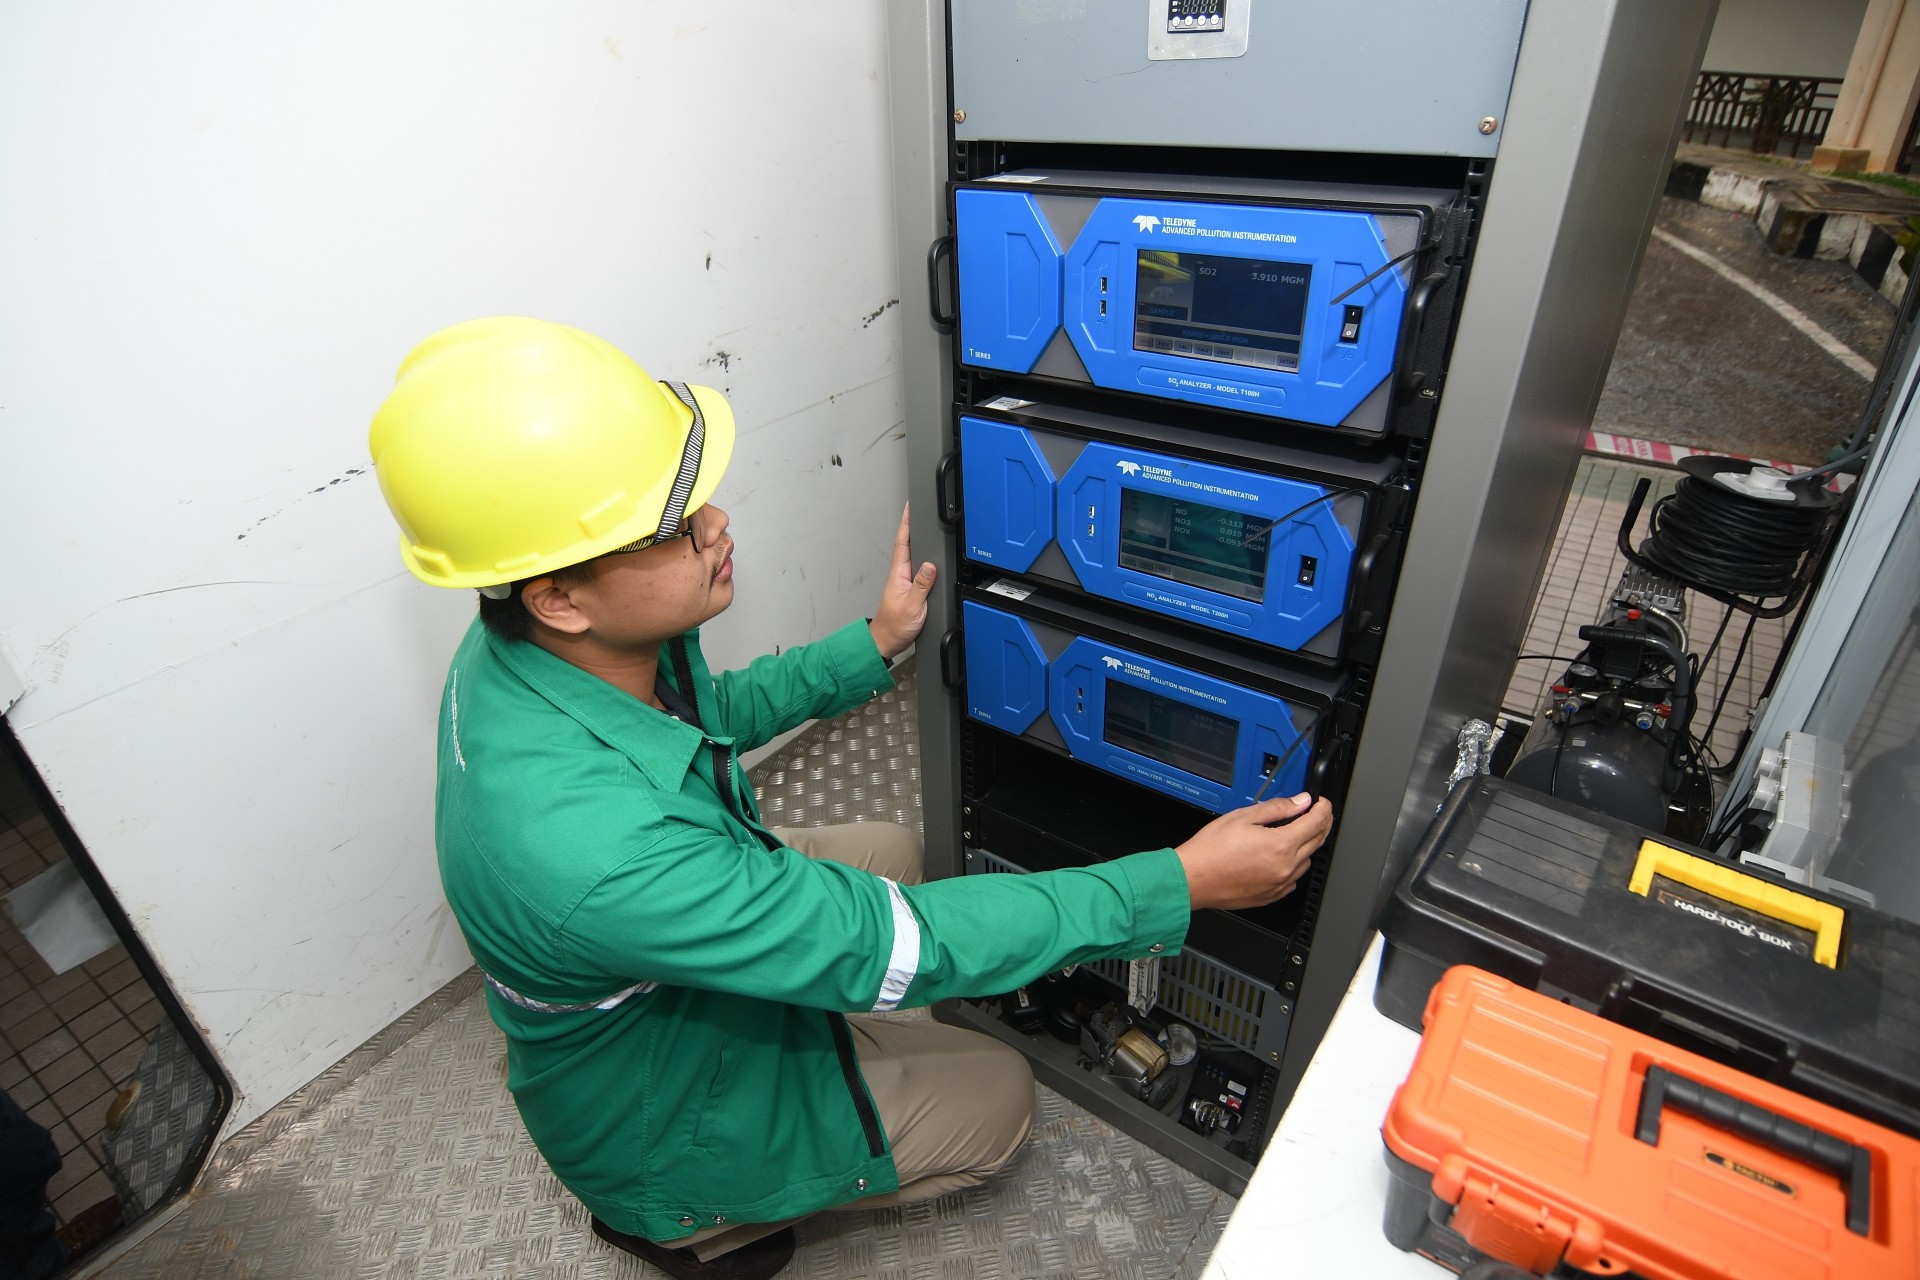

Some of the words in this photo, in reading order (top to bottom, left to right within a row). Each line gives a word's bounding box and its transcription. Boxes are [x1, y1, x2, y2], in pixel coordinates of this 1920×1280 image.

[1162, 217, 1196, 228] TELEDYNE
[1162, 226, 1196, 236] ADVANCED
[1196, 228, 1231, 238] POLLUTION
[1232, 231, 1297, 244] INSTRUMENTATION
[1199, 267, 1216, 276] SO2
[1281, 275, 1304, 285] MGM
[969, 348, 974, 356] T
[975, 352, 991, 360] SERIES
[1179, 379, 1212, 390] ANALYZER
[1216, 385, 1239, 394] MODEL
[1142, 465, 1172, 476] TELEDYNE
[1142, 472, 1171, 483] ADVANCED
[1172, 478, 1202, 490] POLLUTION
[1203, 484, 1259, 501] INSTRUMENTATION
[1175, 507, 1187, 516] NO
[1175, 517, 1191, 526] NO2
[1174, 526, 1191, 535] NOX
[1244, 543, 1264, 552] MGM
[1158, 596, 1186, 608] ANALYZER
[1191, 604, 1210, 614] MODEL
[1125, 662, 1151, 675] TELEDYNE
[1124, 668, 1150, 680] ADVANCED
[1151, 676, 1177, 689] POLLUTION
[1178, 683, 1226, 704] INSTRUMENTATION
[1137, 769, 1163, 782] ANALYZER
[1166, 779, 1184, 790] MODEL
[1674, 900, 1716, 920] HARD
[1759, 931, 1792, 950] BOX
